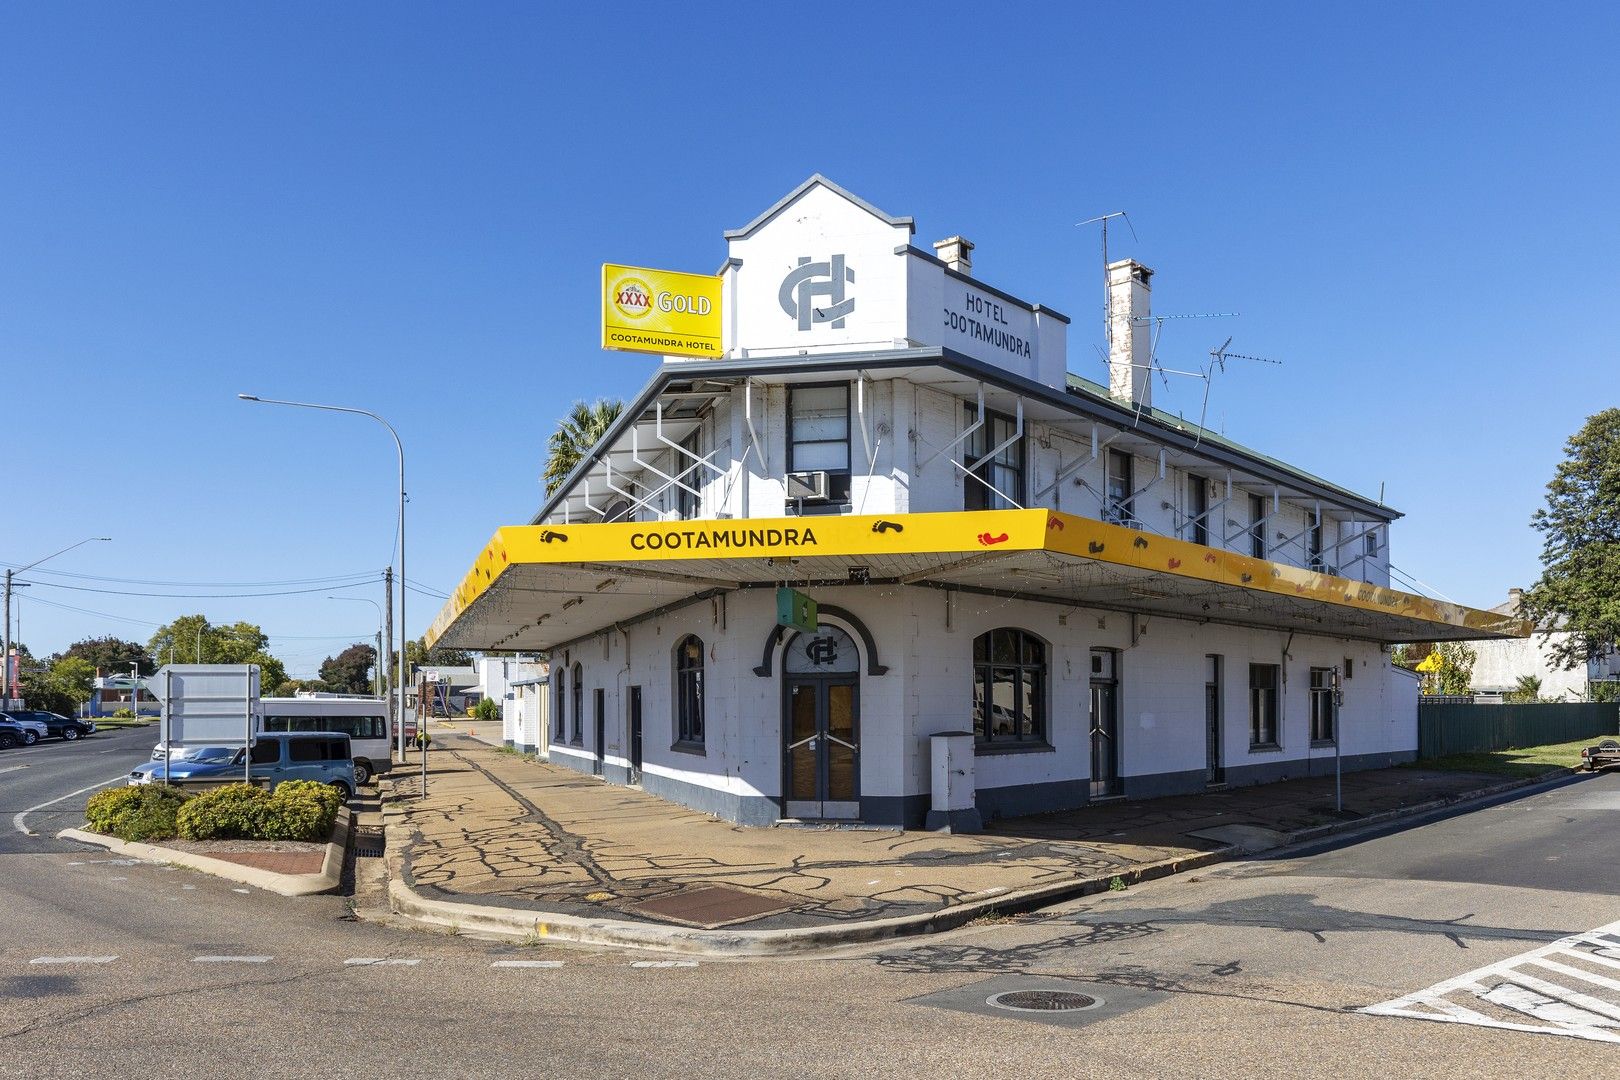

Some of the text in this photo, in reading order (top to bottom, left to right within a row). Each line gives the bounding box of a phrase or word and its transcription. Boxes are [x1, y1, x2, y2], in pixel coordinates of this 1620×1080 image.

[615, 291, 712, 316] XXXX GOLD
[966, 292, 1008, 325] HOTEL
[611, 333, 715, 351] COOTAMUNDRA HOTEL
[943, 308, 1031, 359] COOTAMUNDRA
[630, 528, 818, 550] COOTAMUNDRA
